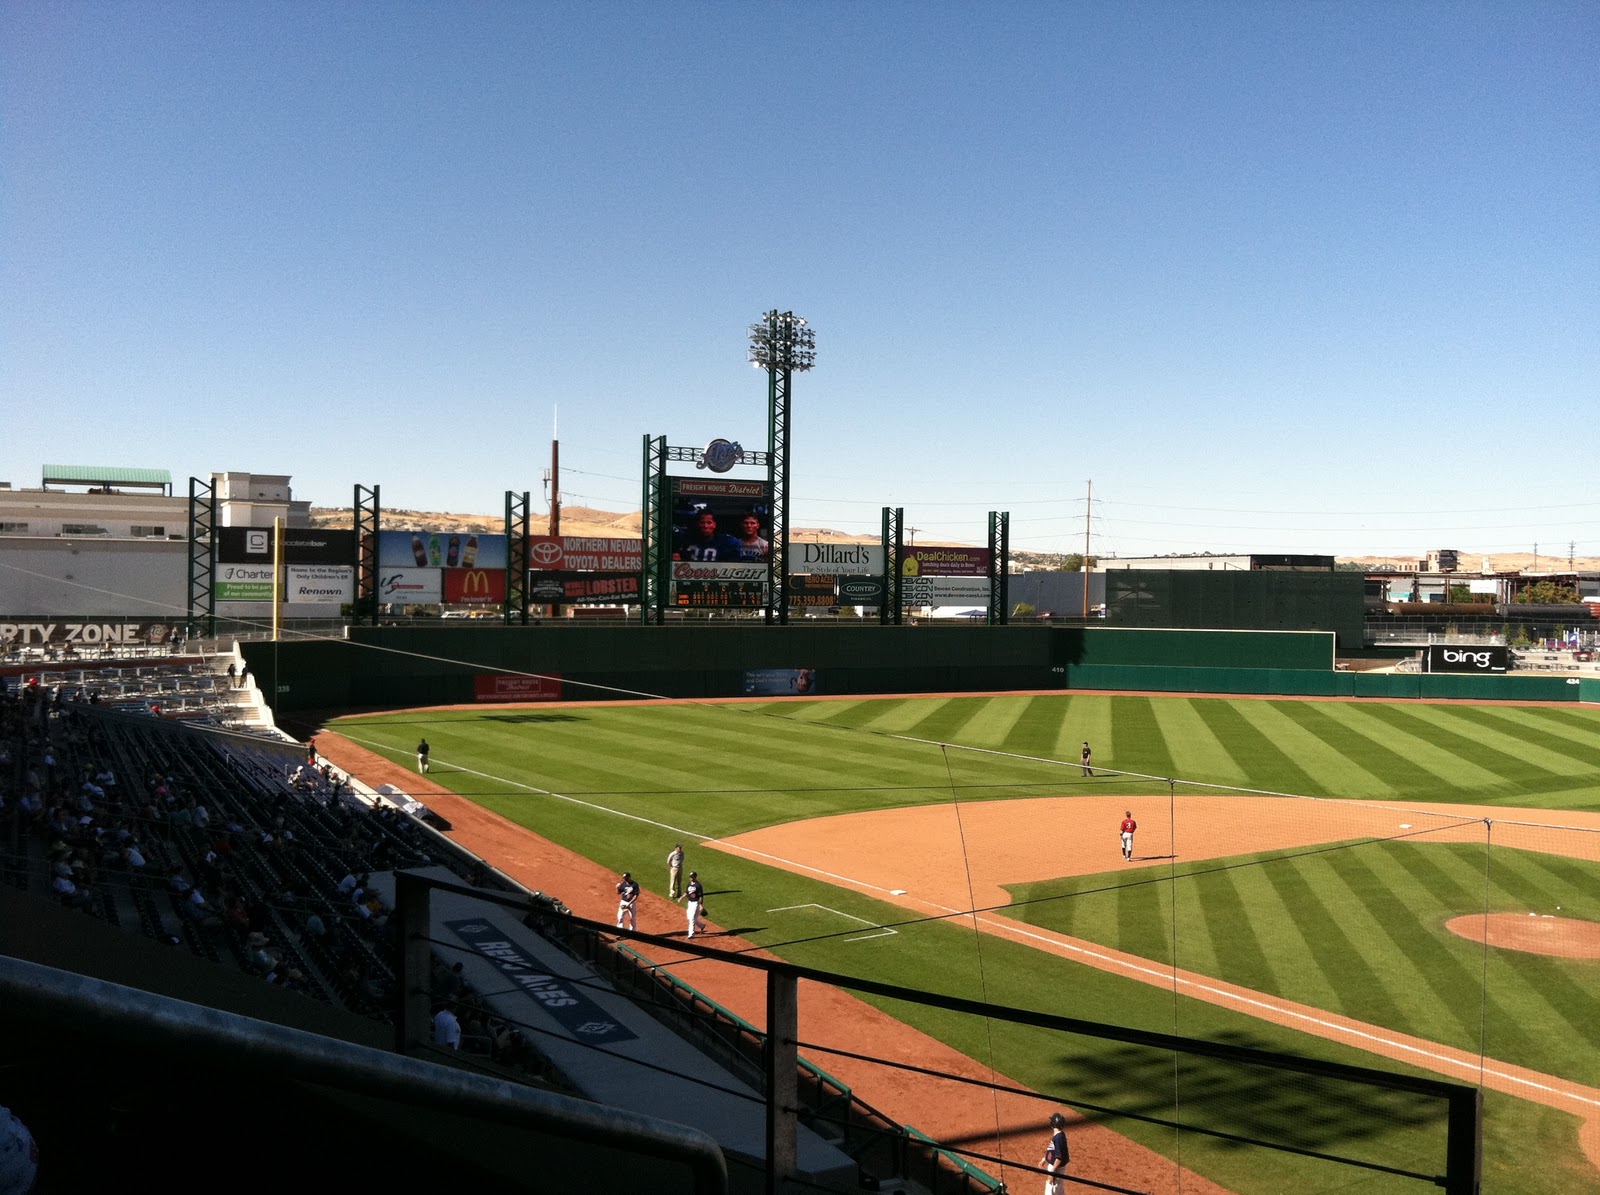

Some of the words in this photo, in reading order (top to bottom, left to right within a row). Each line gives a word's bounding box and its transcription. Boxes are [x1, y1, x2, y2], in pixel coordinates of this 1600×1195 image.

[682, 483, 706, 491] FREIGHT
[707, 484, 726, 493] HOUSE
[728, 484, 760, 494] District
[563, 538, 609, 552] NORTHERN
[610, 539, 642, 553] NEVADA
[803, 543, 870, 565] Dillard's
[916, 551, 981, 561] DealChicken.com
[563, 555, 600, 569] TOYOTA
[601, 556, 642, 570] DEALERS
[802, 565, 815, 573] The
[816, 565, 832, 573] Style
[832, 565, 840, 573] of
[236, 569, 274, 579] Charter
[674, 563, 719, 580] Coors
[718, 568, 766, 579] LIGHT
[299, 586, 342, 596] Renown
[585, 577, 638, 595] LOBSTER
[65, 623, 140, 644] ZONE
[1443, 649, 1493, 668] bing
[513, 974, 580, 1008] ACES
